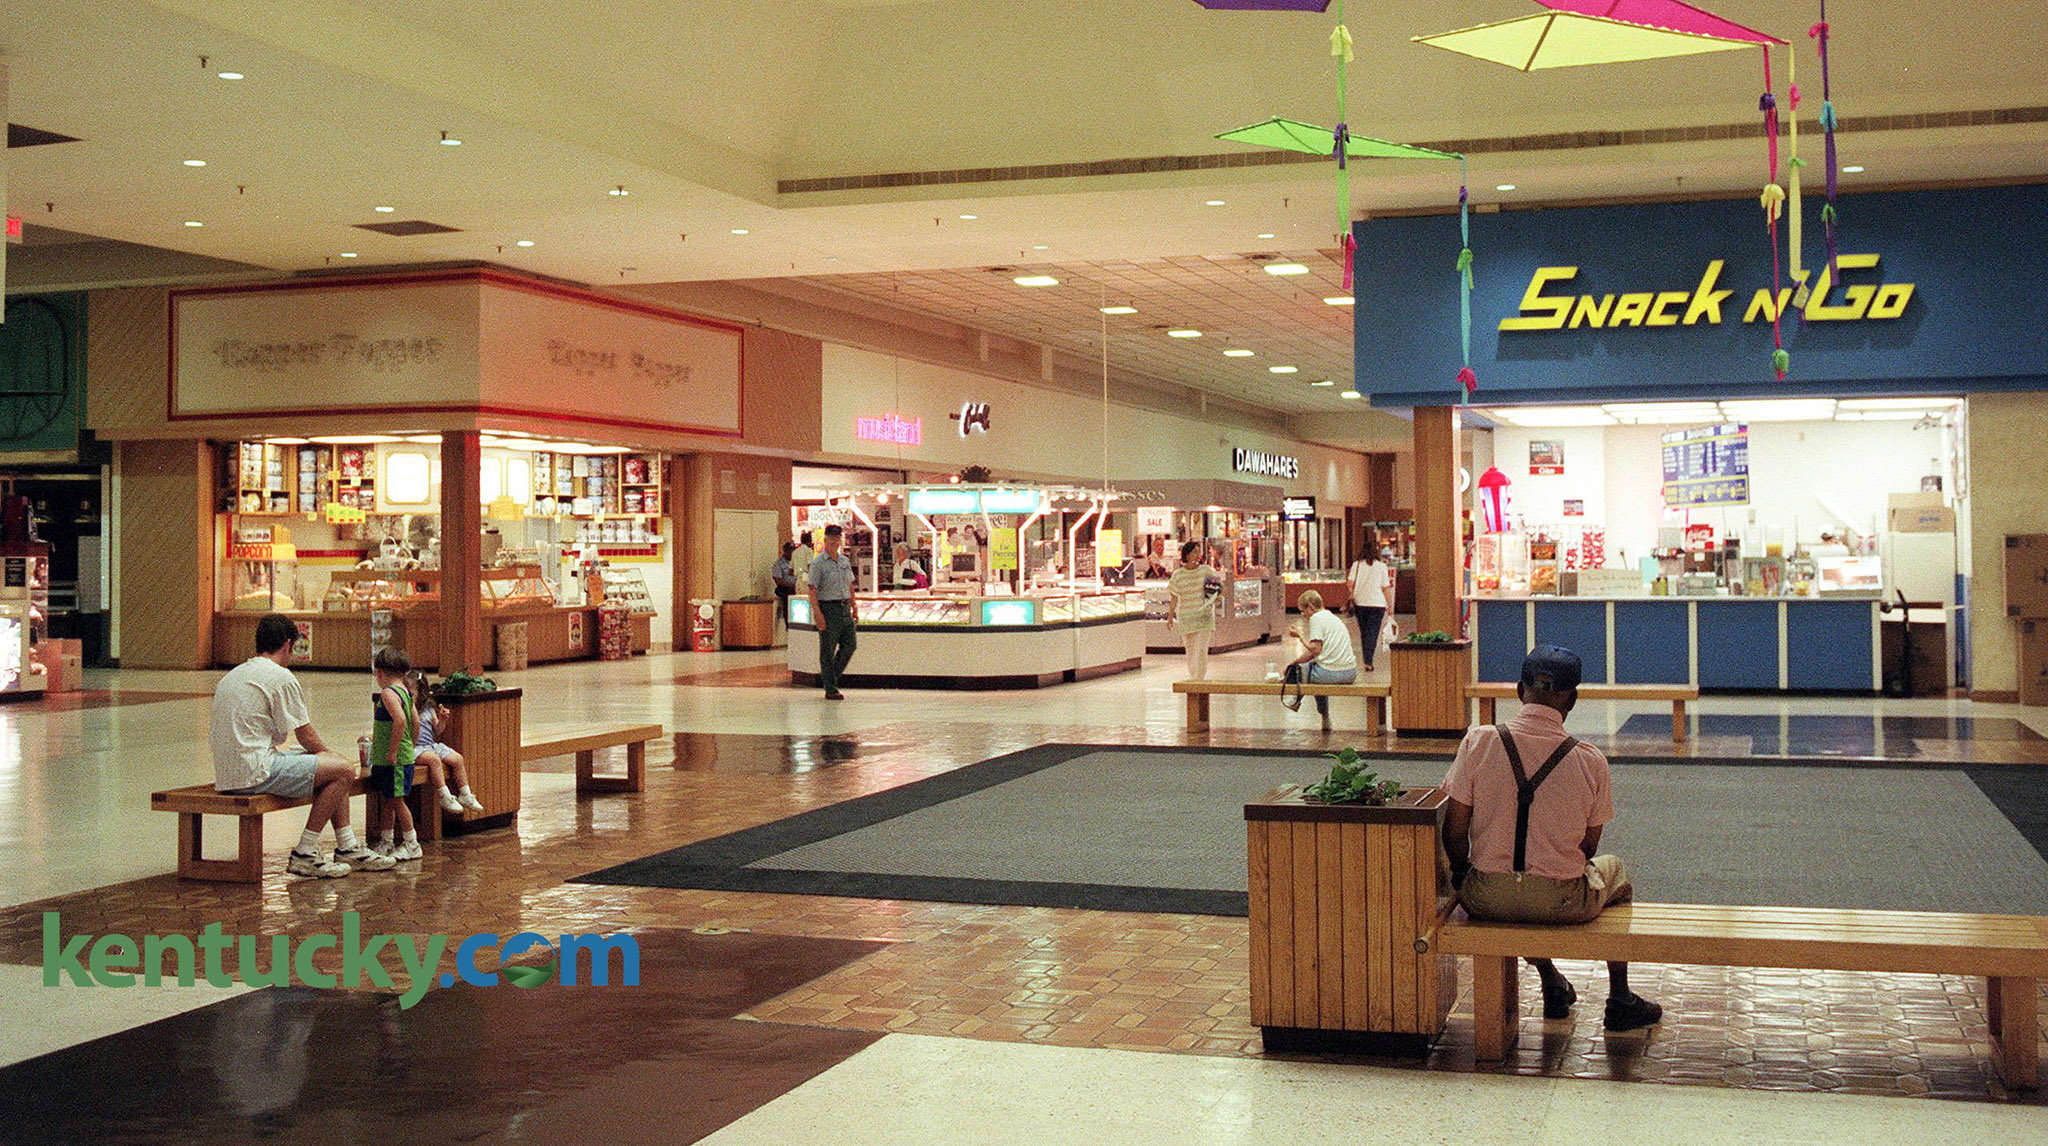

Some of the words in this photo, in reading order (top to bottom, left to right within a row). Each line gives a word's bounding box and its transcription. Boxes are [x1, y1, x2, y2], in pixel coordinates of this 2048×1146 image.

[857, 413, 921, 445] musicland
[1233, 448, 1299, 479] DAWAHARES
[1147, 518, 1163, 527] SALE
[233, 545, 273, 559] POPCORN
